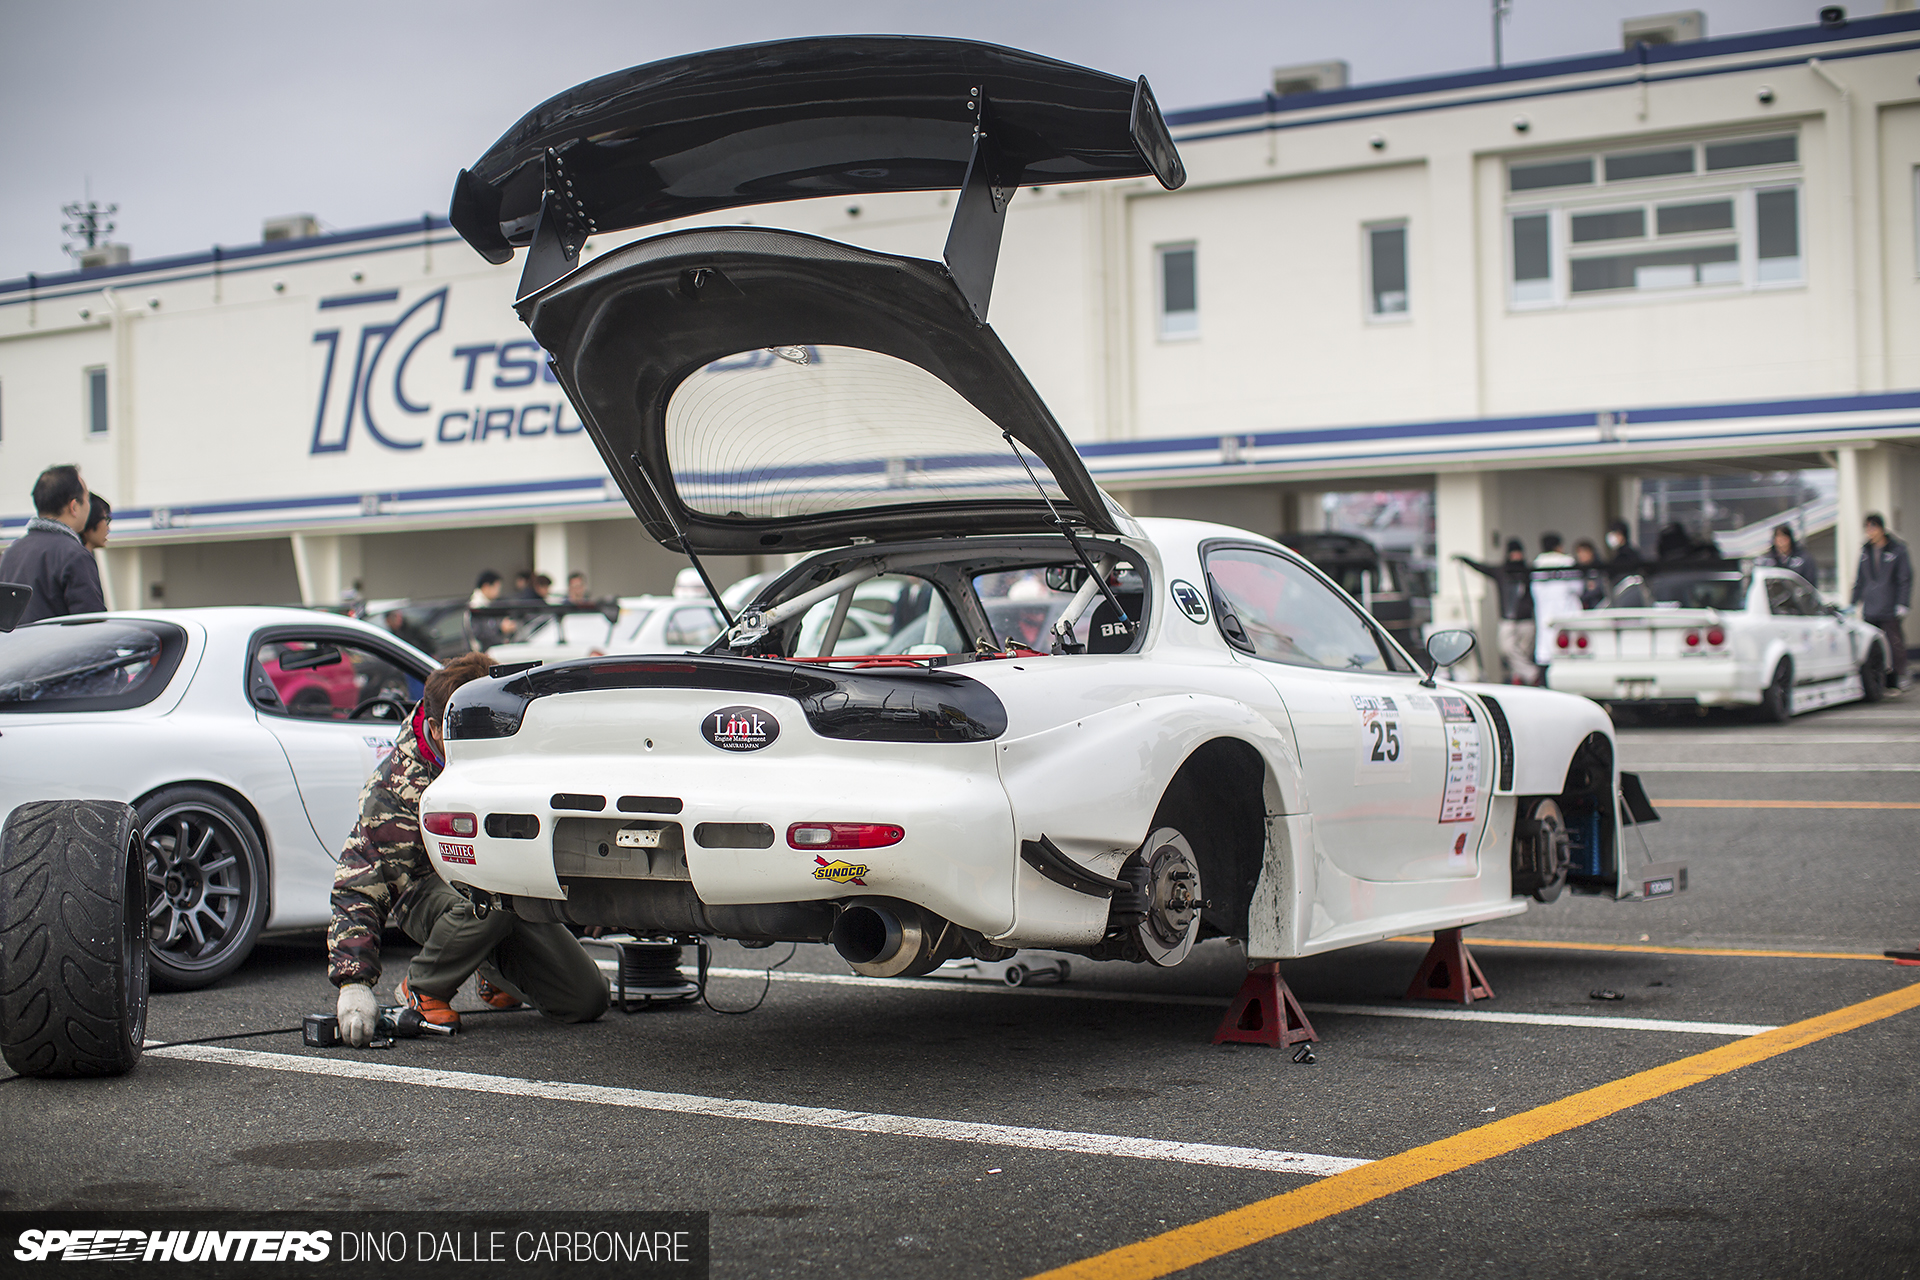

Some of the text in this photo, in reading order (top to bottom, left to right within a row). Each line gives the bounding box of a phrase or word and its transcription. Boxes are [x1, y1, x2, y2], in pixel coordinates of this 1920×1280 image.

[310, 286, 450, 455] TC
[714, 713, 766, 736] Link
[733, 735, 767, 743] Management
[1370, 720, 1400, 762] 25
[439, 843, 474, 857] KEMITEC
[817, 866, 865, 878] SUNOCO
